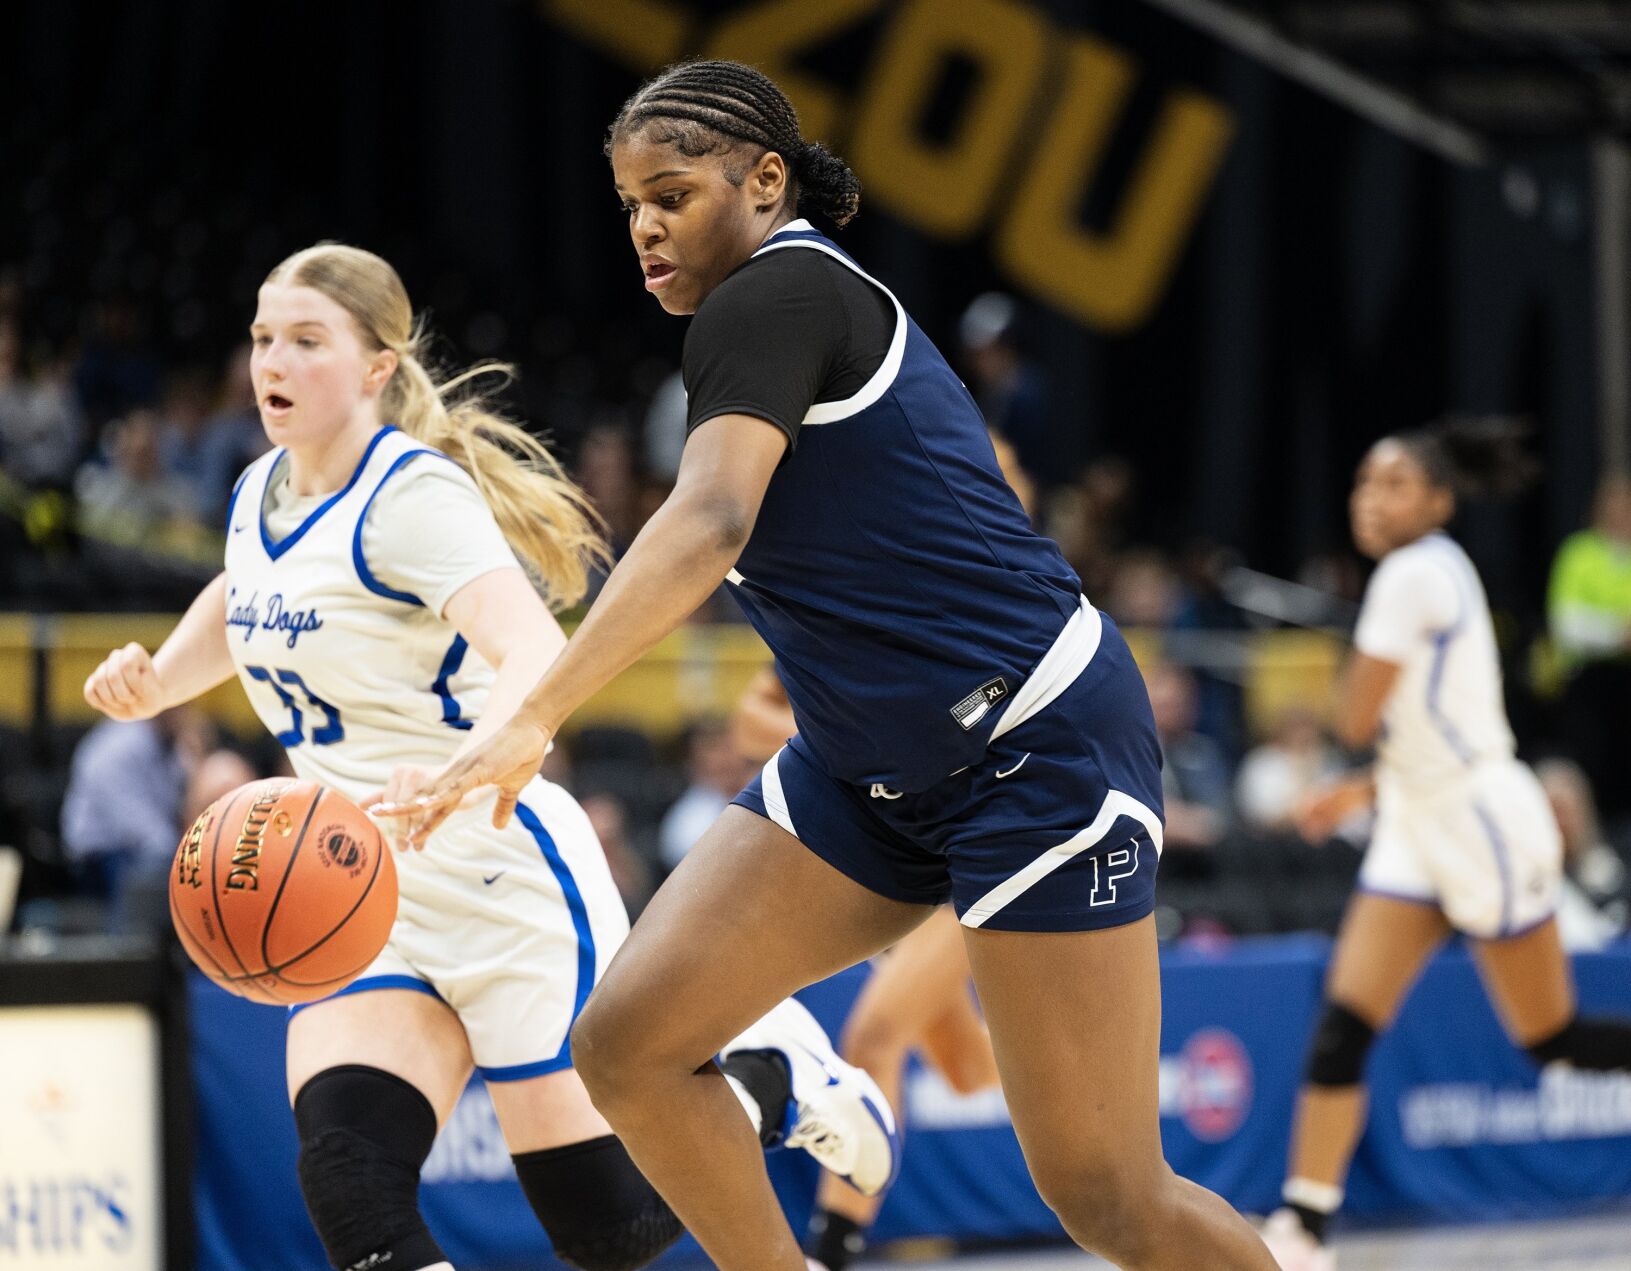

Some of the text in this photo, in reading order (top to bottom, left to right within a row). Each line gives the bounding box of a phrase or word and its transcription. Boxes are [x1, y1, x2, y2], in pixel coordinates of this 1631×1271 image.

[262, 593, 324, 649] Dogs
[244, 665, 346, 750] 33
[986, 685, 1004, 700] XL
[226, 783, 288, 891] PALDING
[1089, 836, 1139, 907] P
